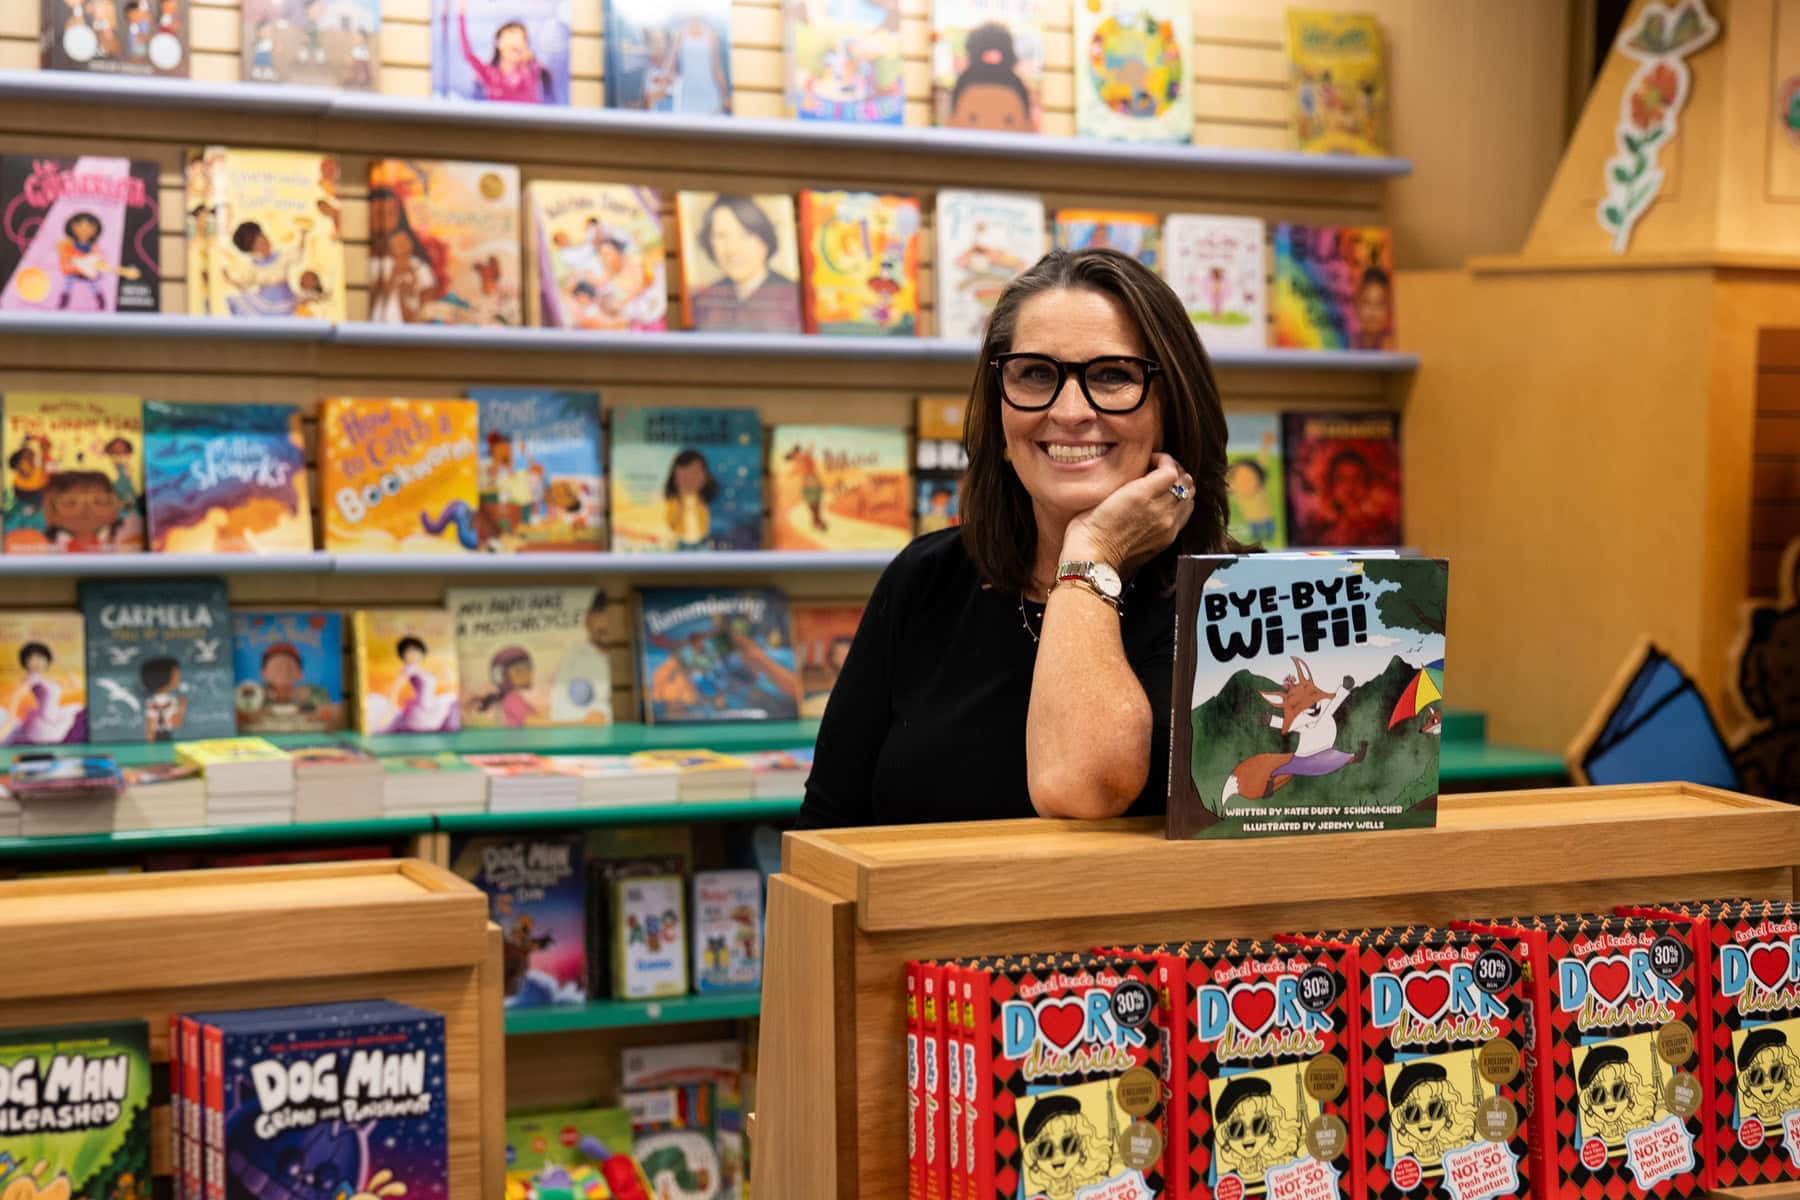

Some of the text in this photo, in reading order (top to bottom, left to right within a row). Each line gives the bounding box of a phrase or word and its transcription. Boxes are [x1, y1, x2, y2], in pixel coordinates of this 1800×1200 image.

[1203, 574, 1371, 622] BYE-BYE,
[100, 604, 213, 629] CARMELA
[1225, 805, 1402, 816] WRITTEN BY KATIE DUFFY SCHUMACHER
[1243, 820, 1384, 832] ILLUSTRATED BY JEREMY WELLS
[1573, 938, 1606, 956] Rachel
[1655, 946, 1679, 965] 30%
[1388, 950, 1425, 971] Rachel
[1479, 958, 1506, 979] 30%
[1302, 976, 1329, 1000] 30%
[1116, 990, 1145, 1015] 30%
[1578, 992, 1675, 1032] diaries
[1391, 1009, 1500, 1049] diaries
[1216, 1023, 1324, 1064] diaries
[1022, 1039, 1136, 1081] diaries
[44, 1054, 128, 1104] MAN
[251, 1053, 339, 1114] DOG
[343, 1049, 426, 1099] MAN
[1655, 1127, 1671, 1137] from
[1452, 1154, 1473, 1168] Tales
[1473, 1147, 1492, 1158] from
[1640, 1145, 1684, 1171] Posh Paris
[1643, 1155, 1687, 1181] Adventure
[1304, 1182, 1329, 1198] Paris
[1458, 1165, 1507, 1191] Posh Paris
